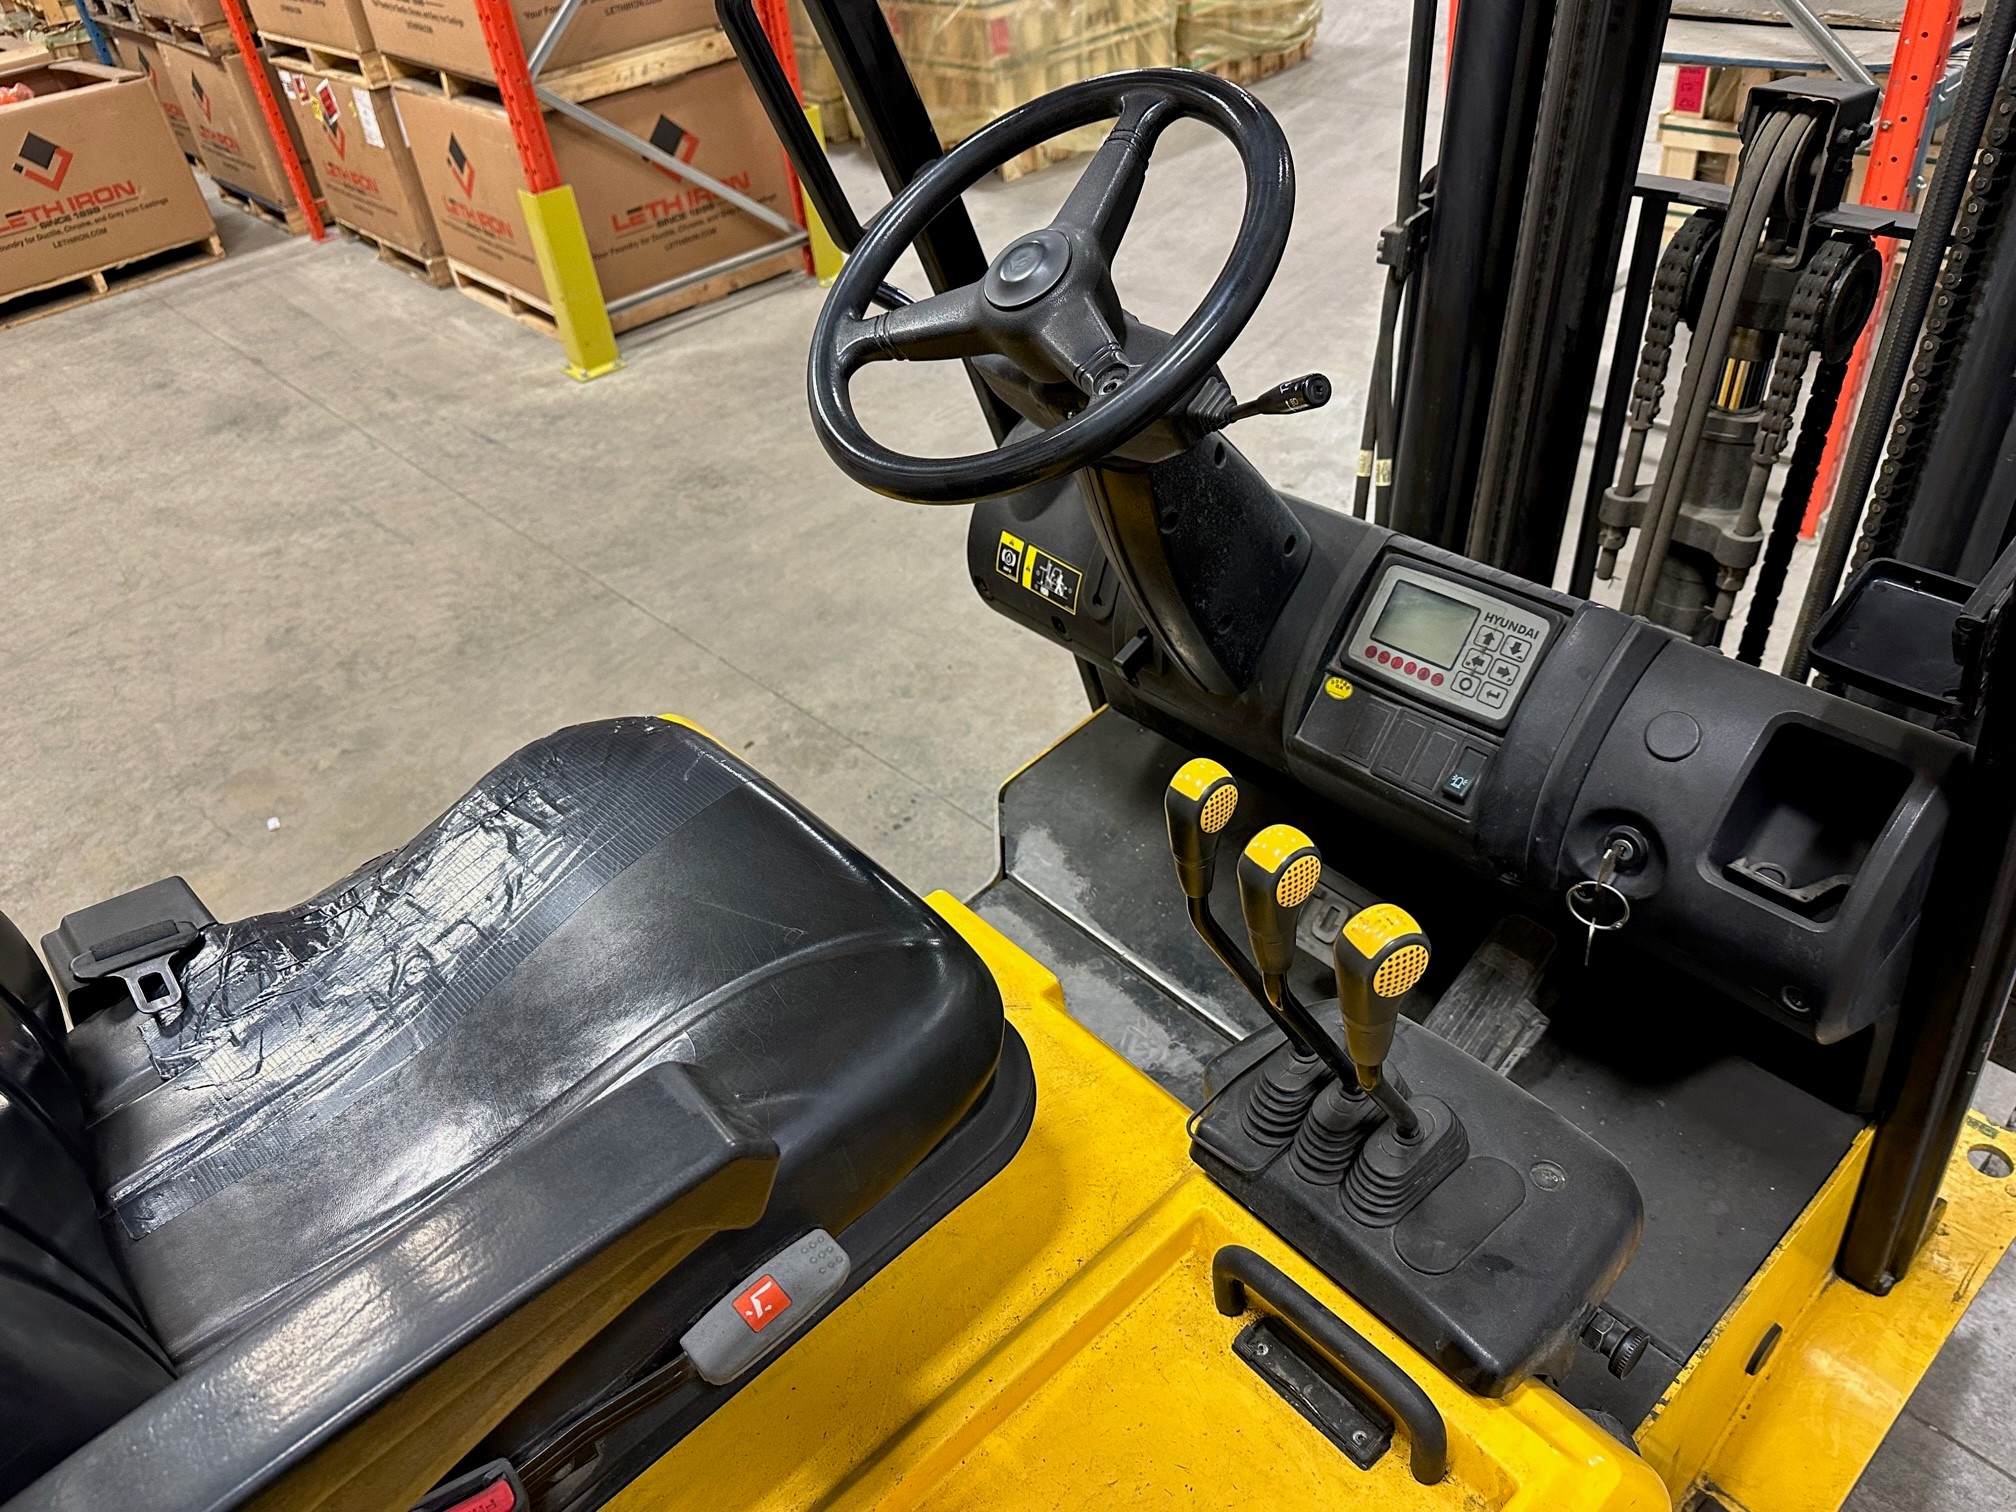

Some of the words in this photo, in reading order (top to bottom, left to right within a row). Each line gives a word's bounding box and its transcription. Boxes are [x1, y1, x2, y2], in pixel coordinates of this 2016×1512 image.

[67, 179, 136, 212] IRON
[39, 215, 73, 230] SINCE
[611, 193, 684, 233] LETH
[0, 237, 25, 251] oundry
[24, 234, 35, 245] for
[94, 214, 107, 223] and
[108, 210, 125, 222] Gray
[1484, 612, 1540, 640] HYUNDAI
